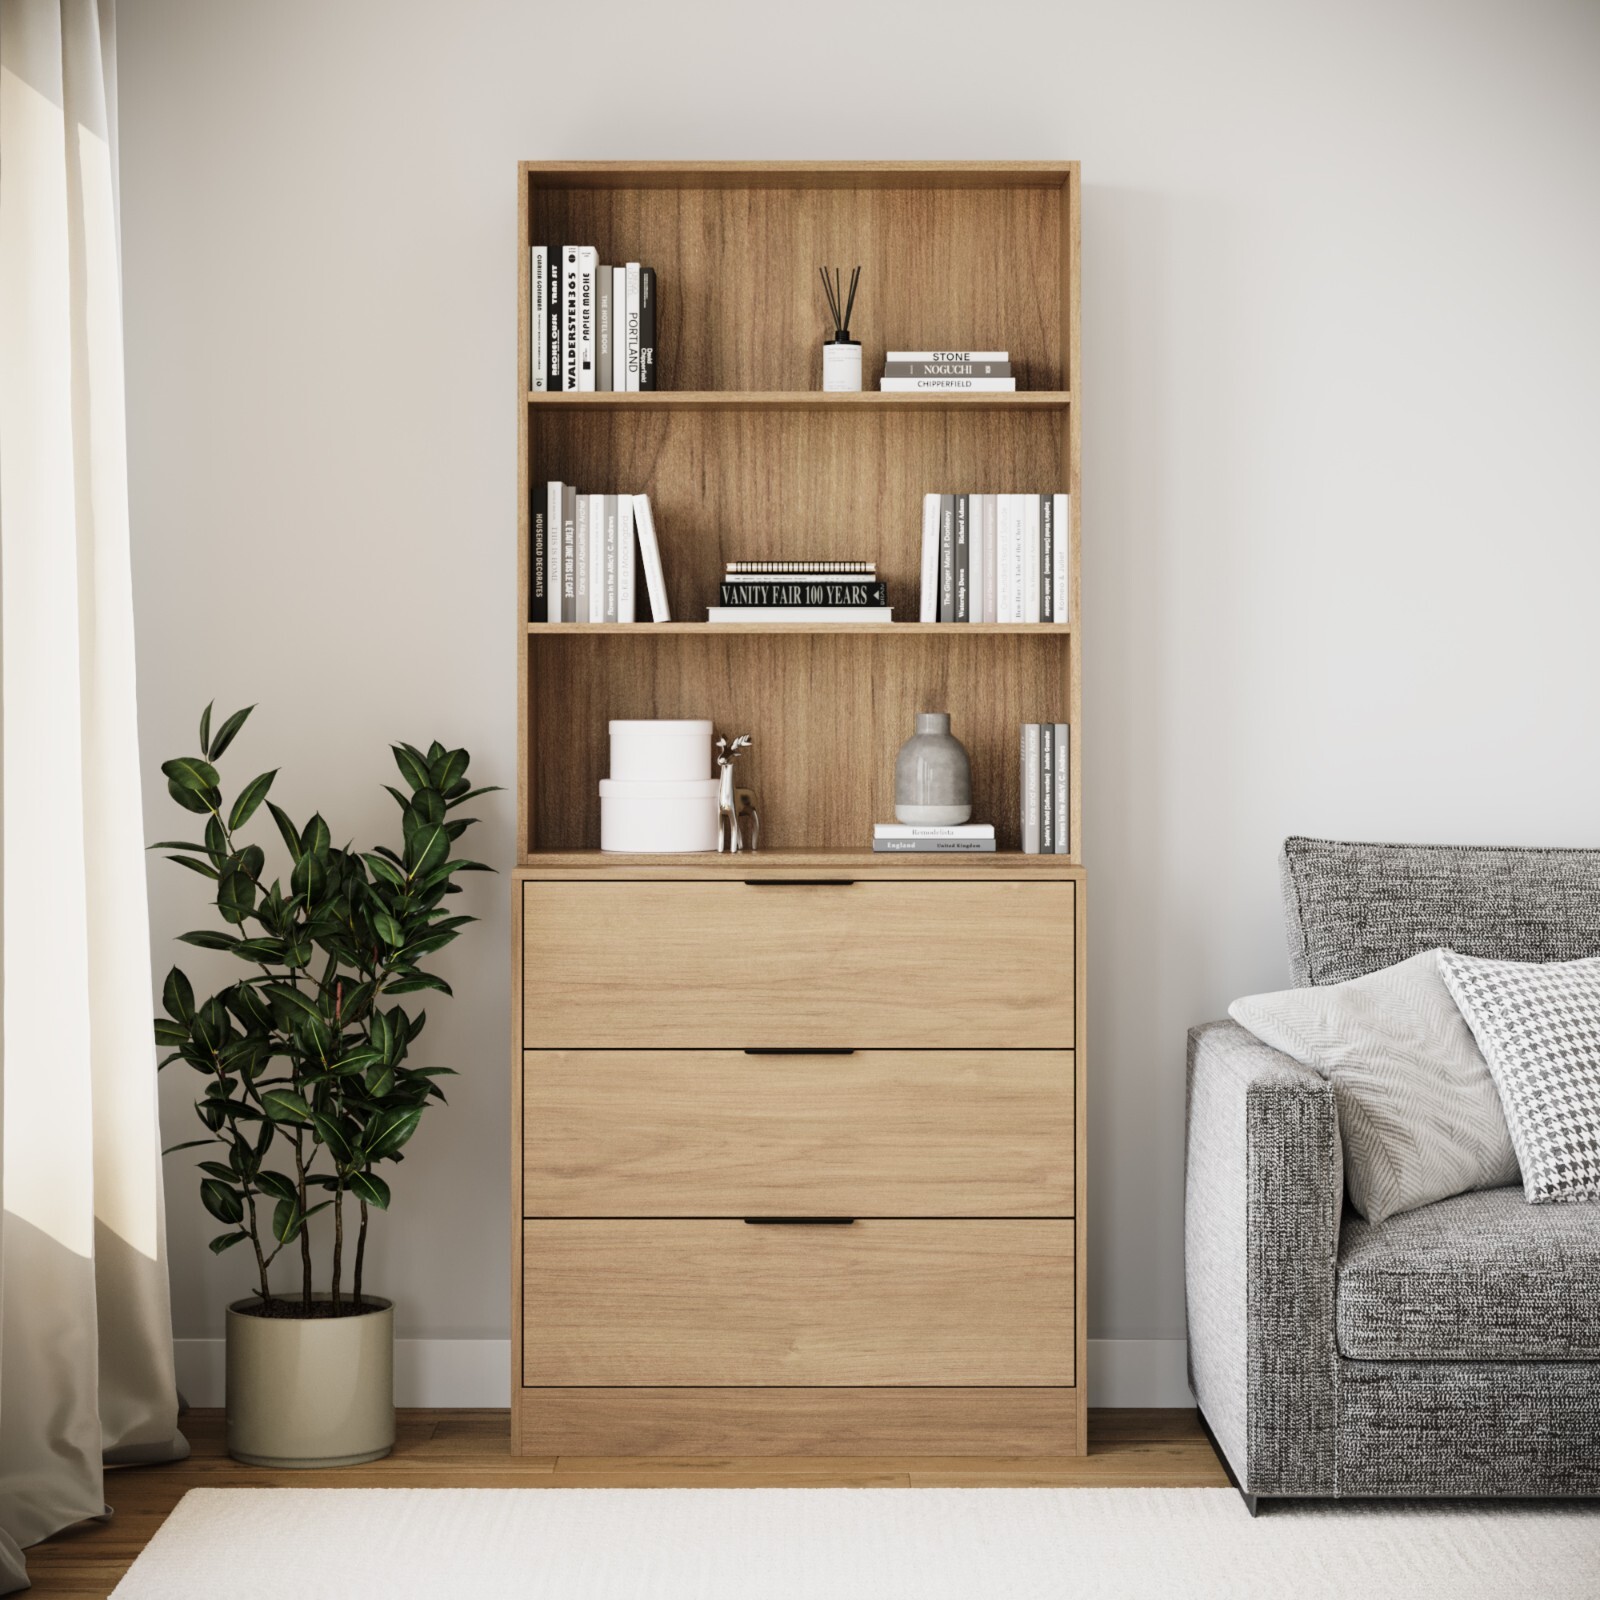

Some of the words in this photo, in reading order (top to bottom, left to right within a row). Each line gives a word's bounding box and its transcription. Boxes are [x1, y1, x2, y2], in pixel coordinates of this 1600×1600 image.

[582, 273, 590, 306] MACHE
[582, 309, 590, 341] PAPIER
[629, 312, 638, 372] PORTLAND
[932, 352, 970, 361] STONE
[924, 365, 972, 374] NOGUCHI
[917, 380, 972, 388] CHIPPERFIELD
[944, 570, 952, 592] Ginger
[722, 586, 769, 604] VANITY
[772, 586, 801, 604] FAIR
[805, 586, 823, 604] 100
[827, 586, 868, 604] YEARS
